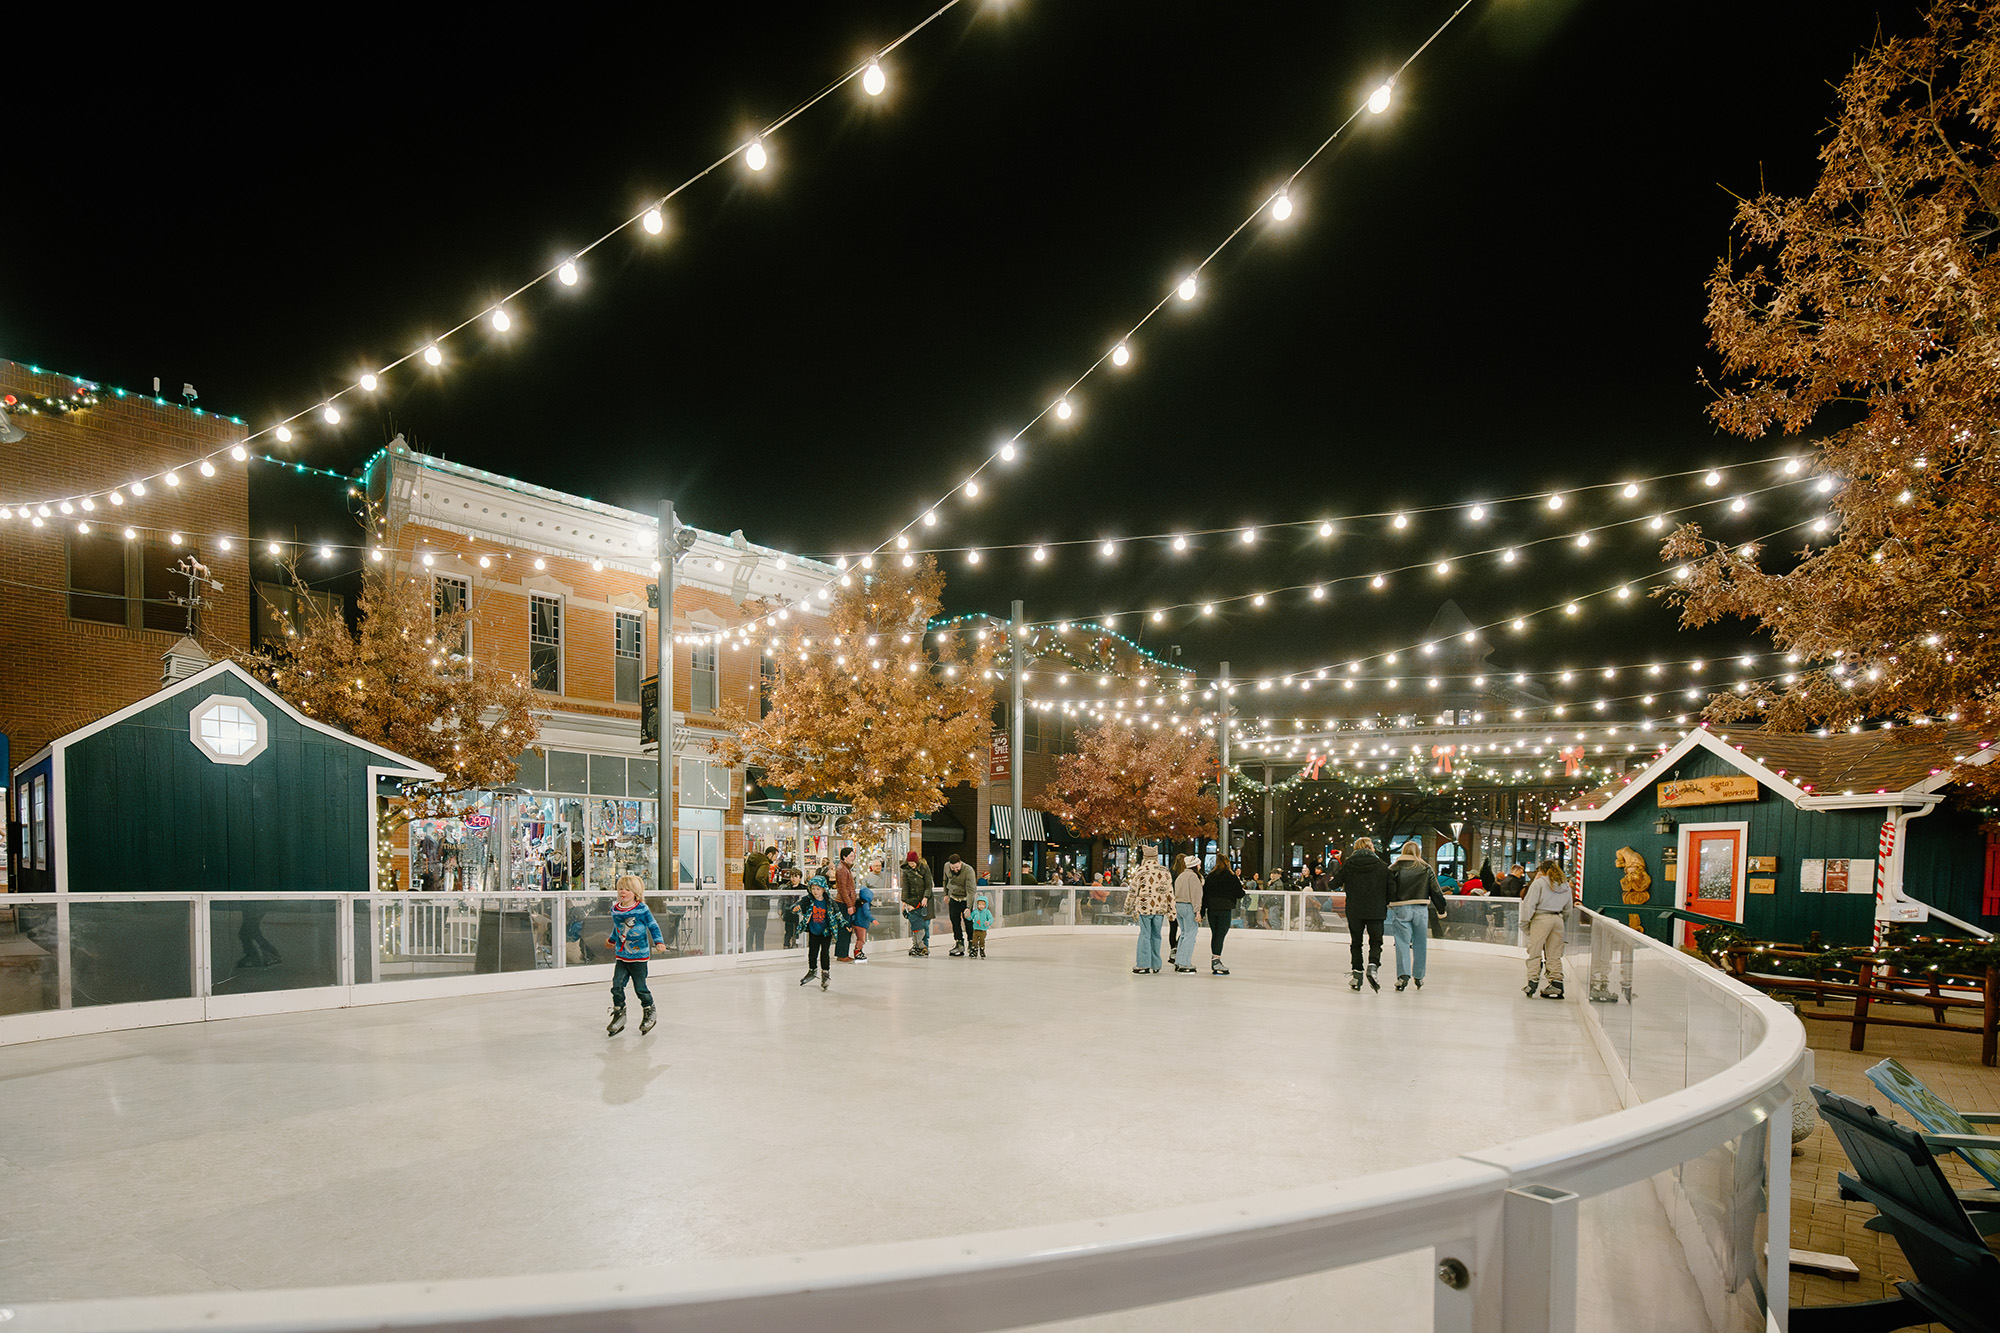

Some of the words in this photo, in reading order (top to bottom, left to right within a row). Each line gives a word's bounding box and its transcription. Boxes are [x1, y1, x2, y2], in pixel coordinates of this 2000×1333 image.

[1710, 780, 1735, 791] Santa's
[1722, 789, 1756, 798] Workshop
[792, 803, 817, 812] RETRO
[821, 804, 847, 815] SPORTS
[465, 814, 491, 827] OPEN
